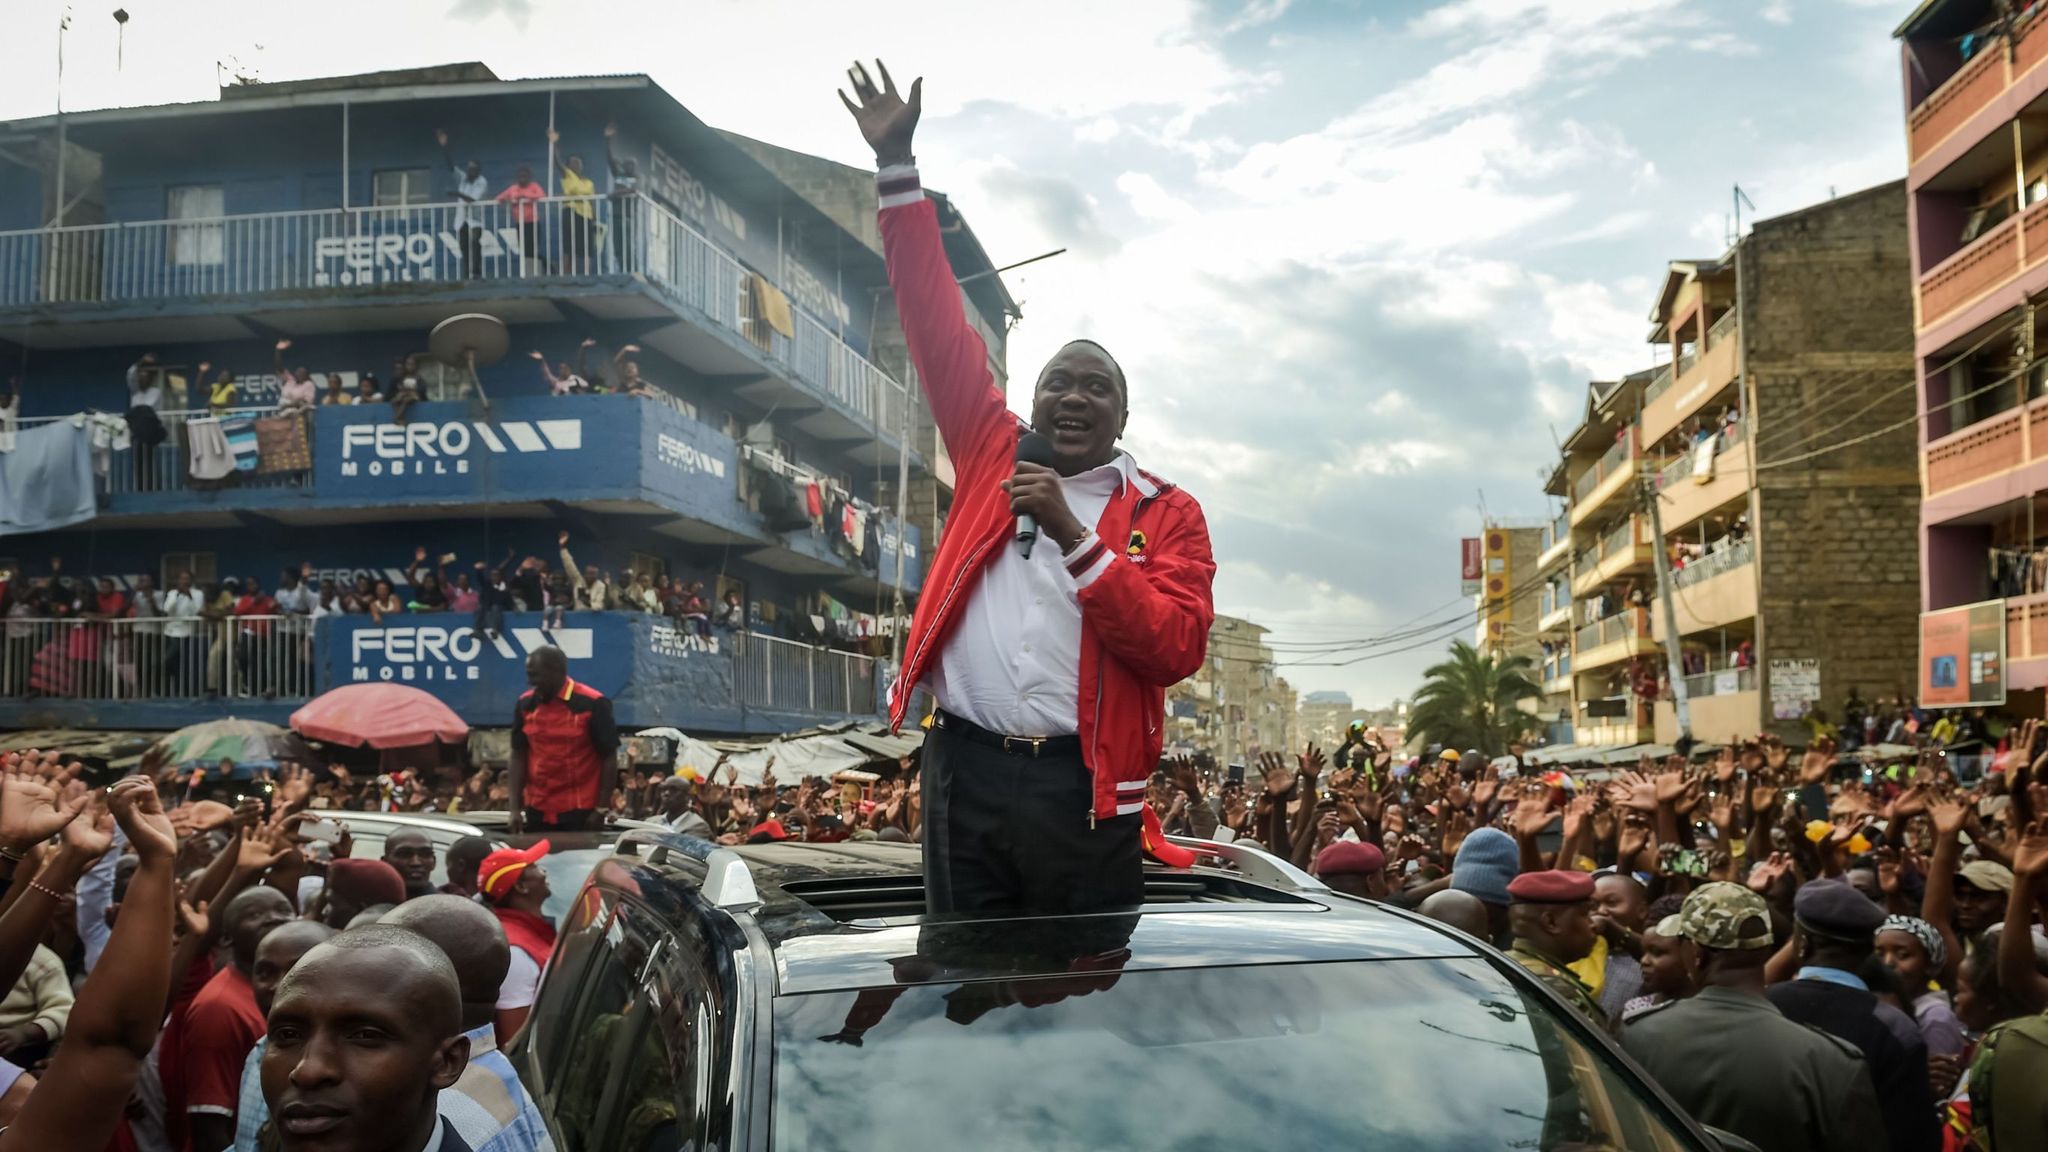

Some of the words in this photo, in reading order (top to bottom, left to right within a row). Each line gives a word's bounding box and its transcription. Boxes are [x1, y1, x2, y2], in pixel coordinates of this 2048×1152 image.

[315, 232, 435, 269] FERO
[342, 421, 470, 459] FERO
[658, 433, 695, 466] FERO
[341, 460, 469, 476] MOBILE
[352, 626, 481, 663] FERO
[352, 665, 480, 681] MOBILE
